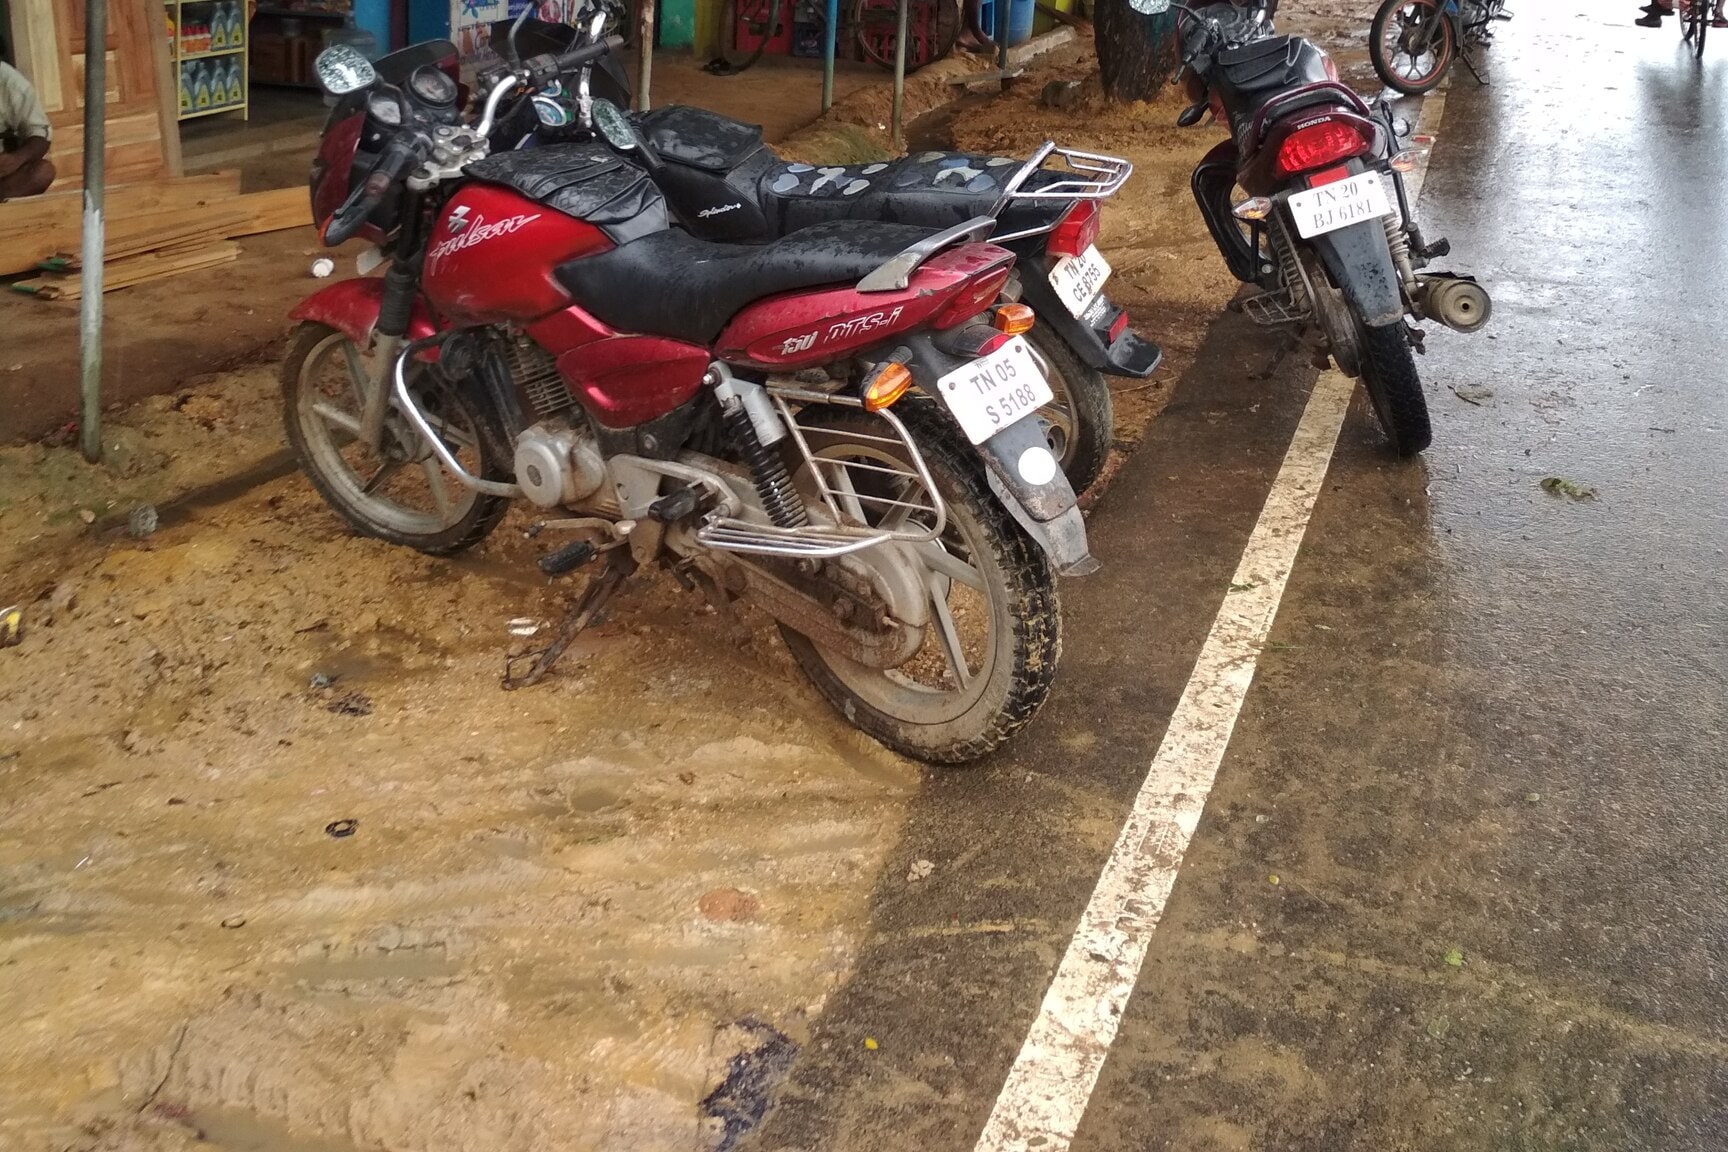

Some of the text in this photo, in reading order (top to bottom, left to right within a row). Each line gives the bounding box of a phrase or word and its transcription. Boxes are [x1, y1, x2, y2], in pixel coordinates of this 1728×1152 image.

[1297, 116, 1332, 130] HONDA
[1313, 182, 1358, 207] TN 20
[1313, 199, 1372, 229] BJ 6181
[1063, 259, 1080, 279] TN
[1073, 282, 1087, 302] CE
[1081, 263, 1101, 289] 8755
[969, 358, 1017, 395] TN 05
[986, 383, 1036, 424] S 5188
